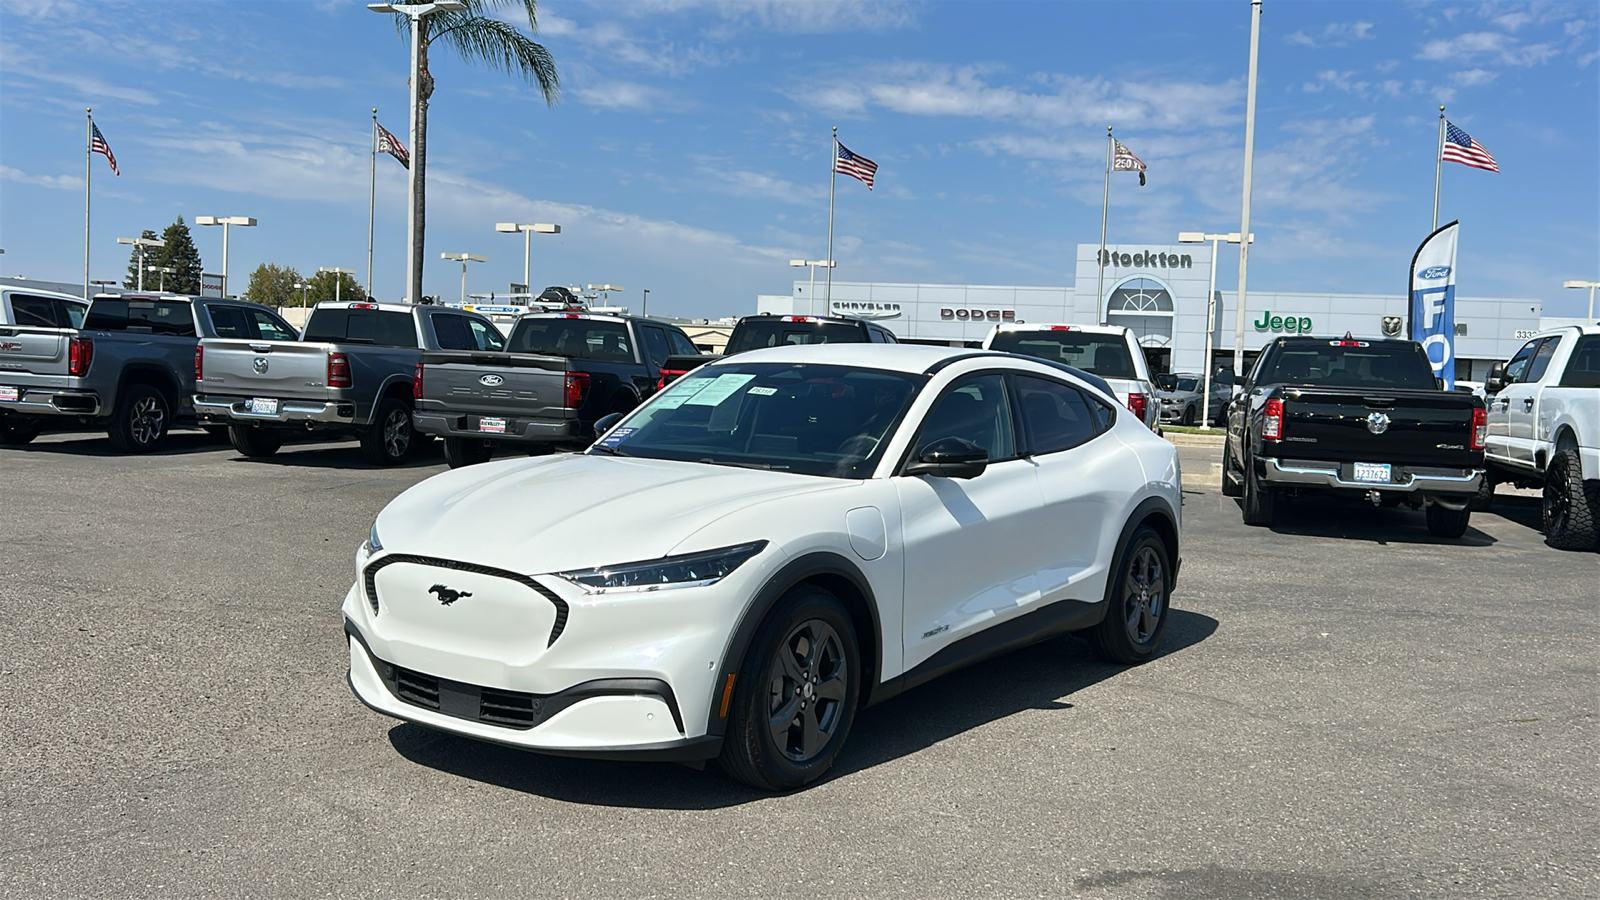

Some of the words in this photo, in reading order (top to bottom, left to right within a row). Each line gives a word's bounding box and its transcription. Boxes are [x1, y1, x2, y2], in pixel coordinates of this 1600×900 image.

[1115, 159, 1132, 168] 250
[1097, 249, 1192, 268] Stockton
[1424, 267, 1448, 279] Ford
[832, 301, 901, 311] CHRYSLER
[940, 308, 1016, 322] DODGE
[1253, 310, 1313, 334] Jeep
[0, 341, 22, 351] MC
